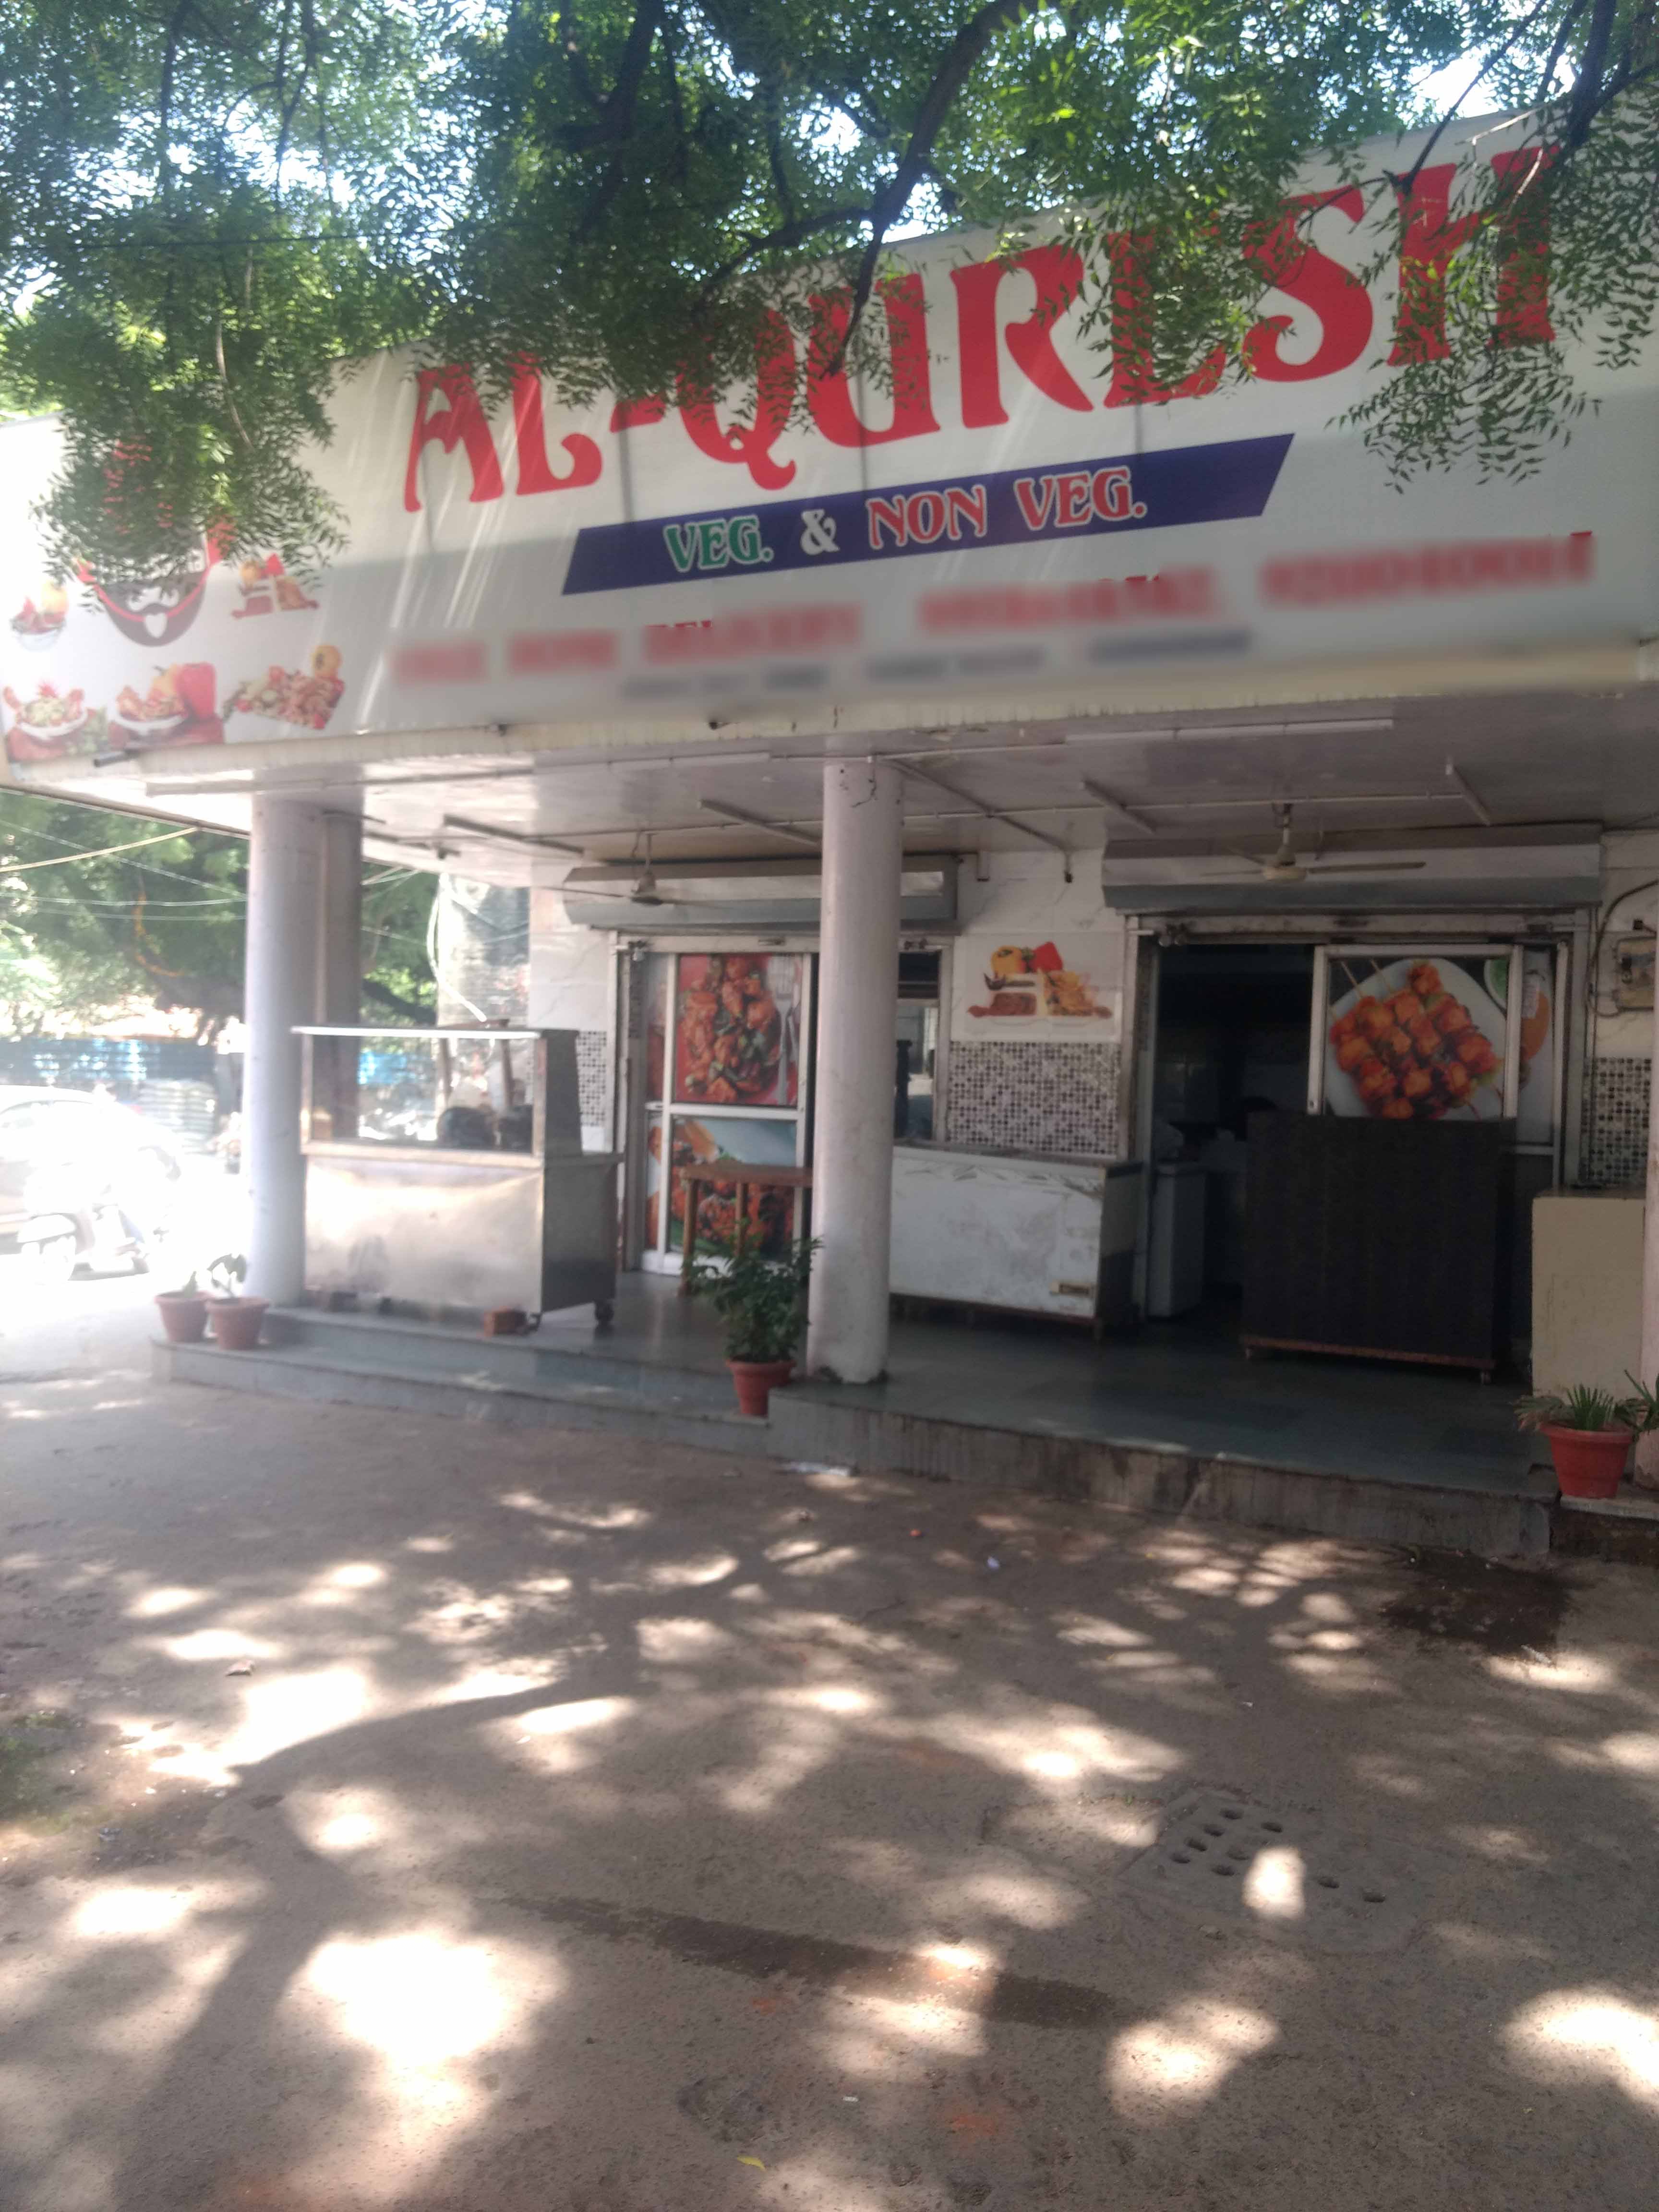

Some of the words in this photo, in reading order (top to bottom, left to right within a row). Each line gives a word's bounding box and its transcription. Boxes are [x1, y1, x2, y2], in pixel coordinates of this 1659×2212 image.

[664, 515, 773, 573] VEG.
[800, 509, 840, 555] &
[866, 484, 987, 550] NON
[1014, 466, 1147, 531] VEG.
